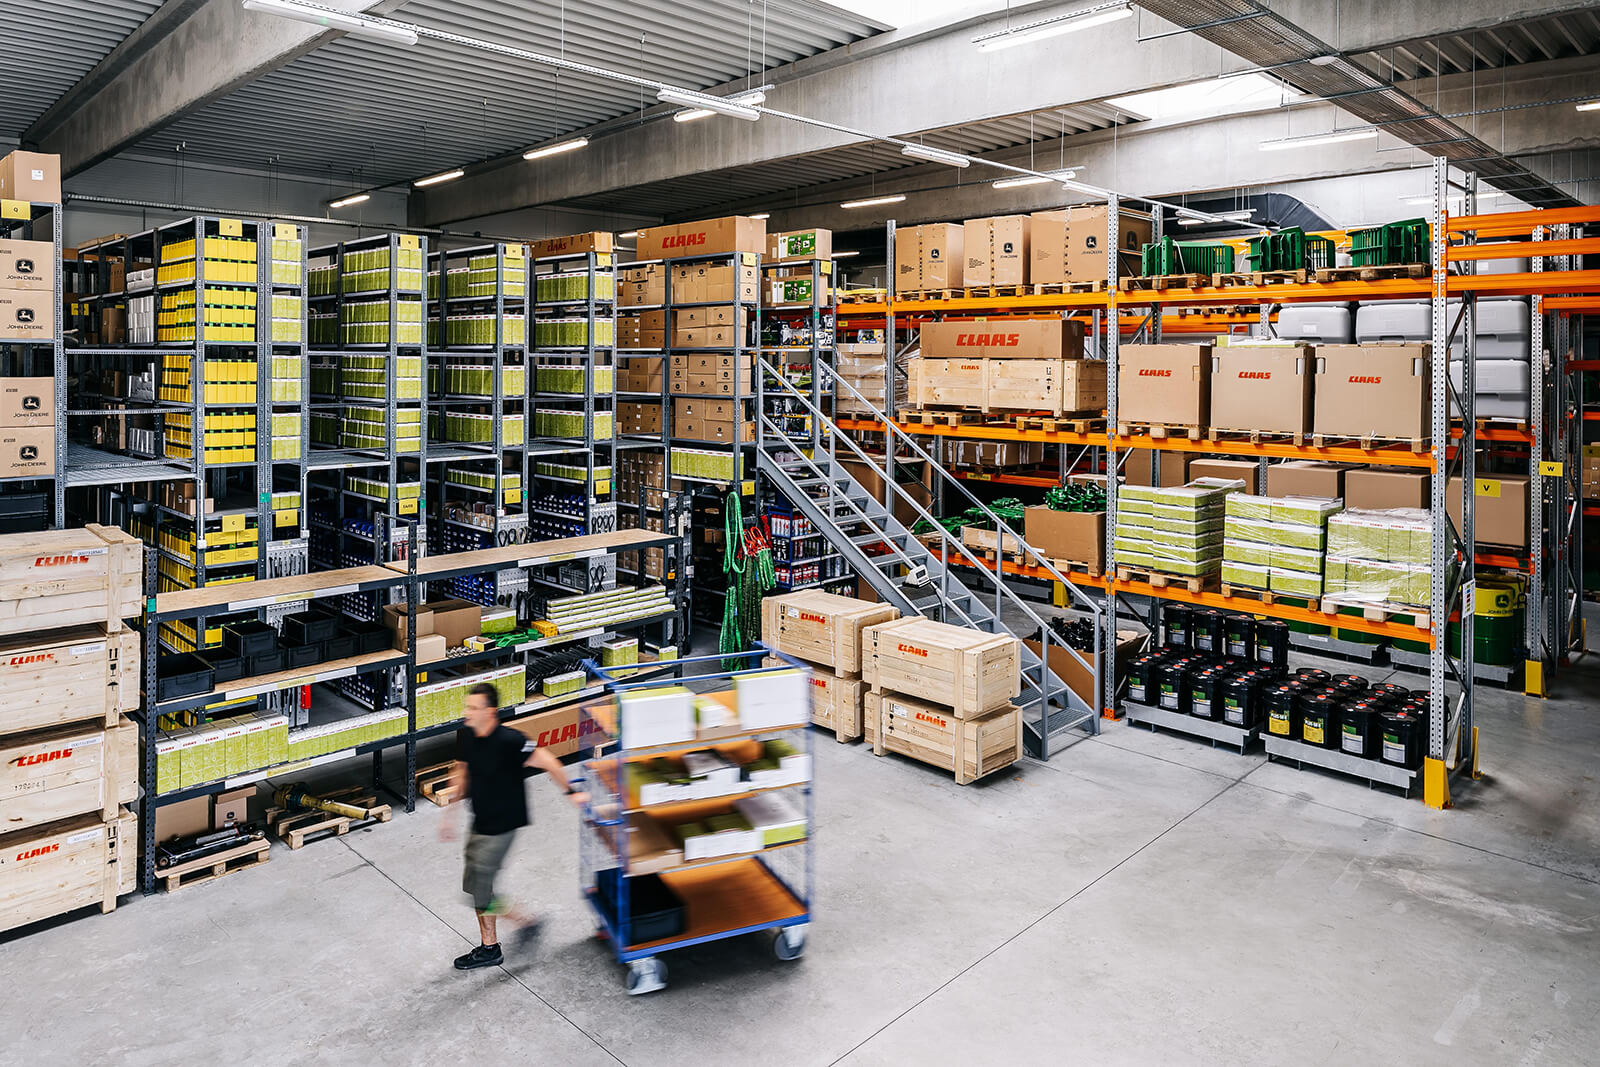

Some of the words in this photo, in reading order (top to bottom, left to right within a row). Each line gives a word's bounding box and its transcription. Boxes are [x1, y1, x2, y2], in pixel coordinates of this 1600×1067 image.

[662, 232, 706, 249] CLAAS
[956, 334, 1020, 346] CLAAS
[1139, 369, 1172, 377] CLAAS
[1238, 371, 1271, 379] CLAAS
[1348, 375, 1382, 384] CLAAS
[35, 555, 89, 567] CLAAS
[800, 613, 826, 624] CLAAS
[897, 643, 928, 657] CLAAS
[10, 653, 55, 666] CLAAS
[915, 712, 947, 728] CLAAS
[17, 748, 73, 767] CLAAS
[16, 843, 60, 861] CLAAS
